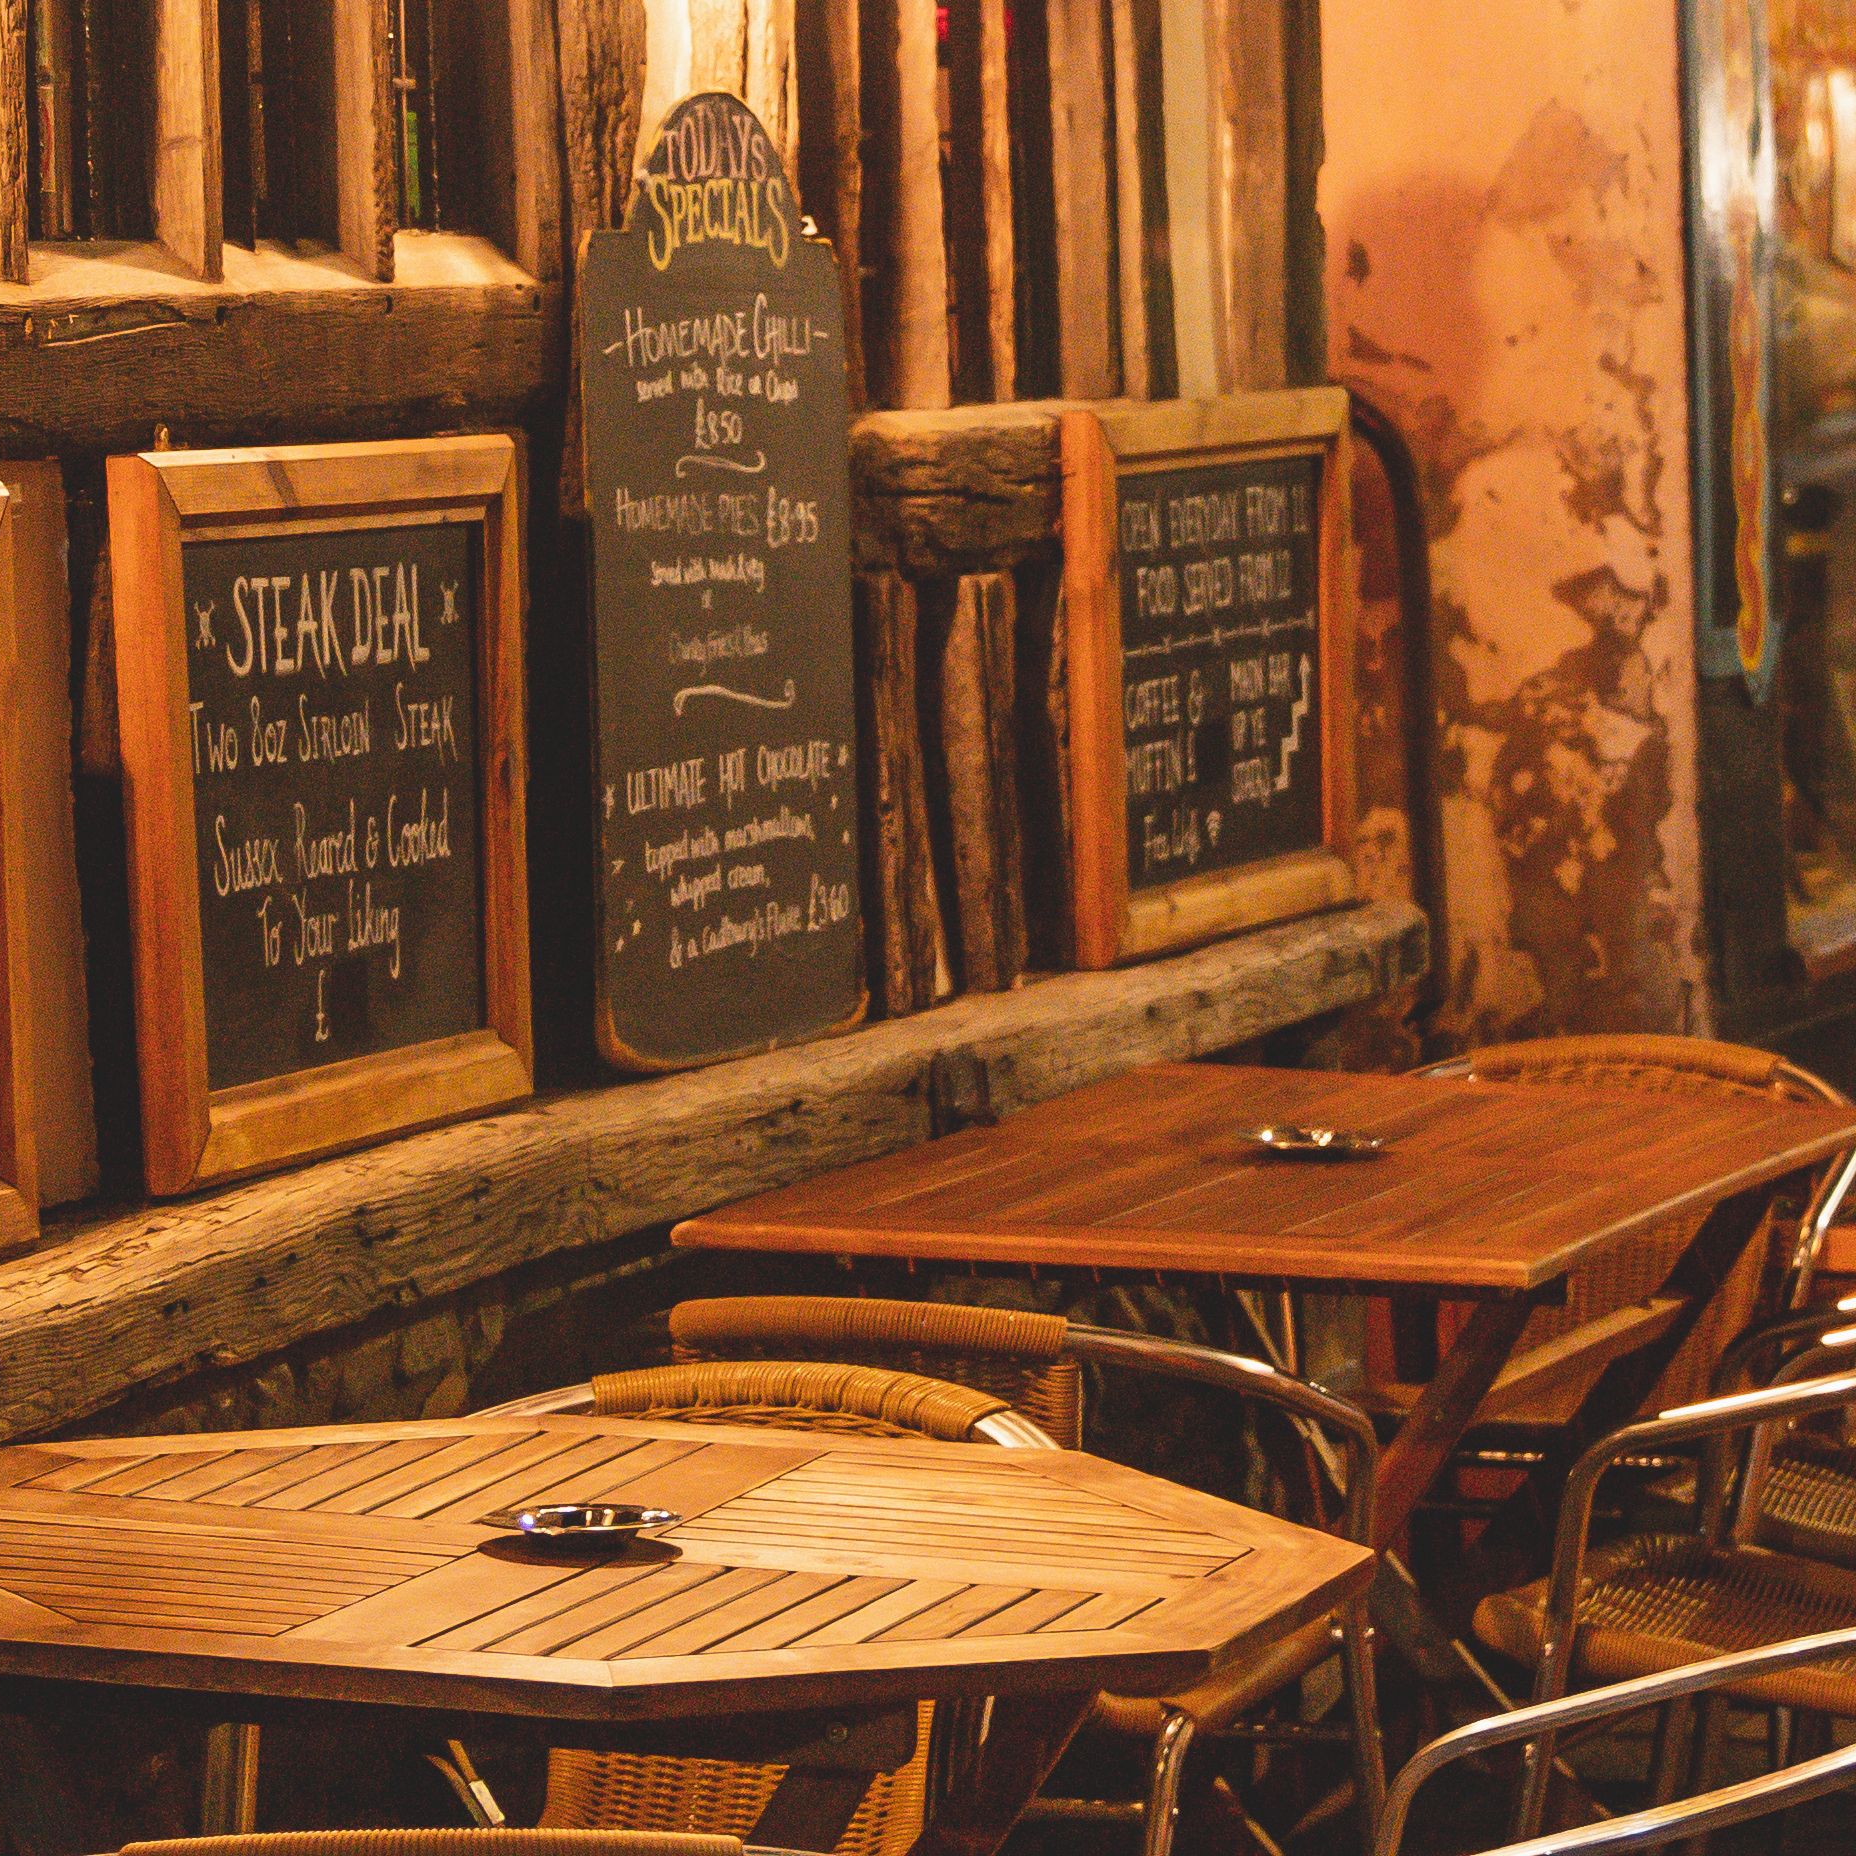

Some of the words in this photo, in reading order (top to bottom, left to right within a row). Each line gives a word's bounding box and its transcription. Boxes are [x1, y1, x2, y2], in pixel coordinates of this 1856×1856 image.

[648, 174, 789, 271] SPECIALS
[225, 569, 349, 679] STEAK
[350, 562, 431, 672] DEAL
[298, 693, 371, 765] SIRLOIN
[394, 681, 459, 766] STEAK
[626, 757, 706, 815] ULTIMATE
[718, 748, 747, 811] HOT
[213, 814, 284, 898] Sussex
[293, 797, 359, 880] Reared
[365, 816, 380, 869] &
[387, 787, 451, 867] Cooked
[256, 895, 284, 968] To
[292, 888, 339, 967] Your
[347, 878, 401, 980] Liking
